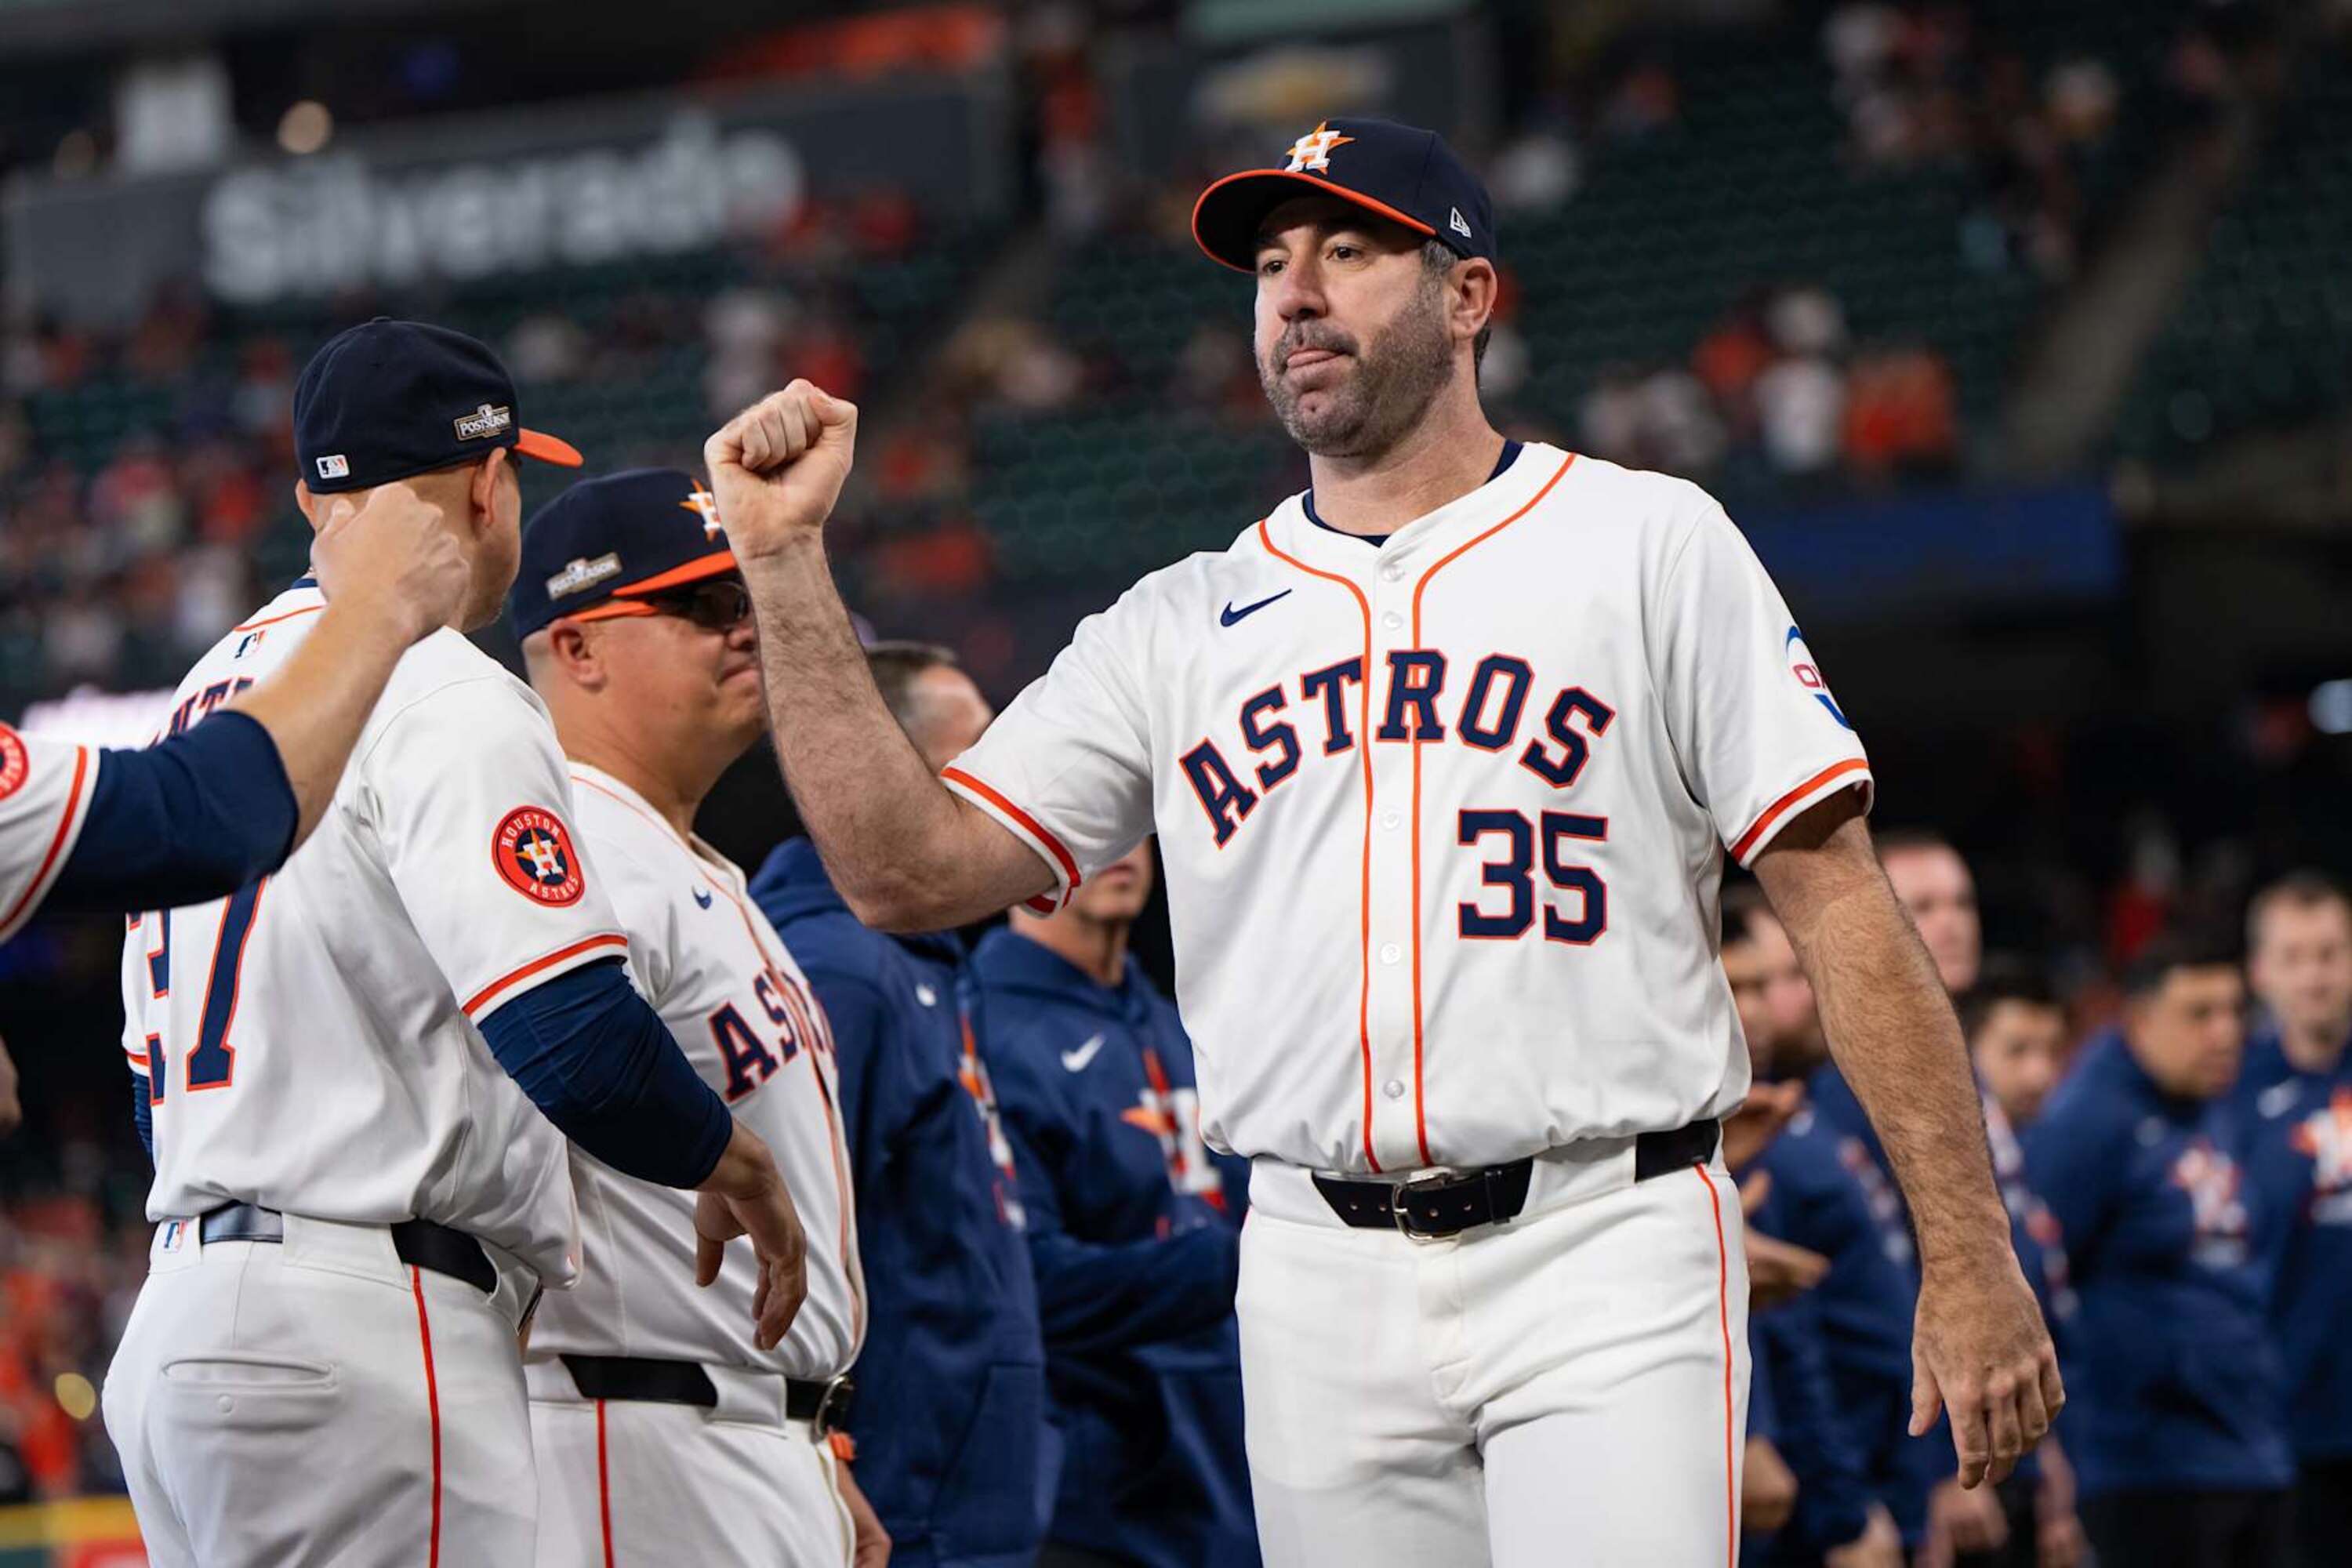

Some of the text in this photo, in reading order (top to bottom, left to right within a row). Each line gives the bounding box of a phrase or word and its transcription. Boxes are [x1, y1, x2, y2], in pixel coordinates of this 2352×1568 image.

[204, 111, 801, 301] Silverado
[1179, 648, 1616, 849] ASTROS
[501, 815, 561, 848] HOUSTON
[529, 875, 579, 899] ASTROS
[1457, 809, 1608, 946] 35
